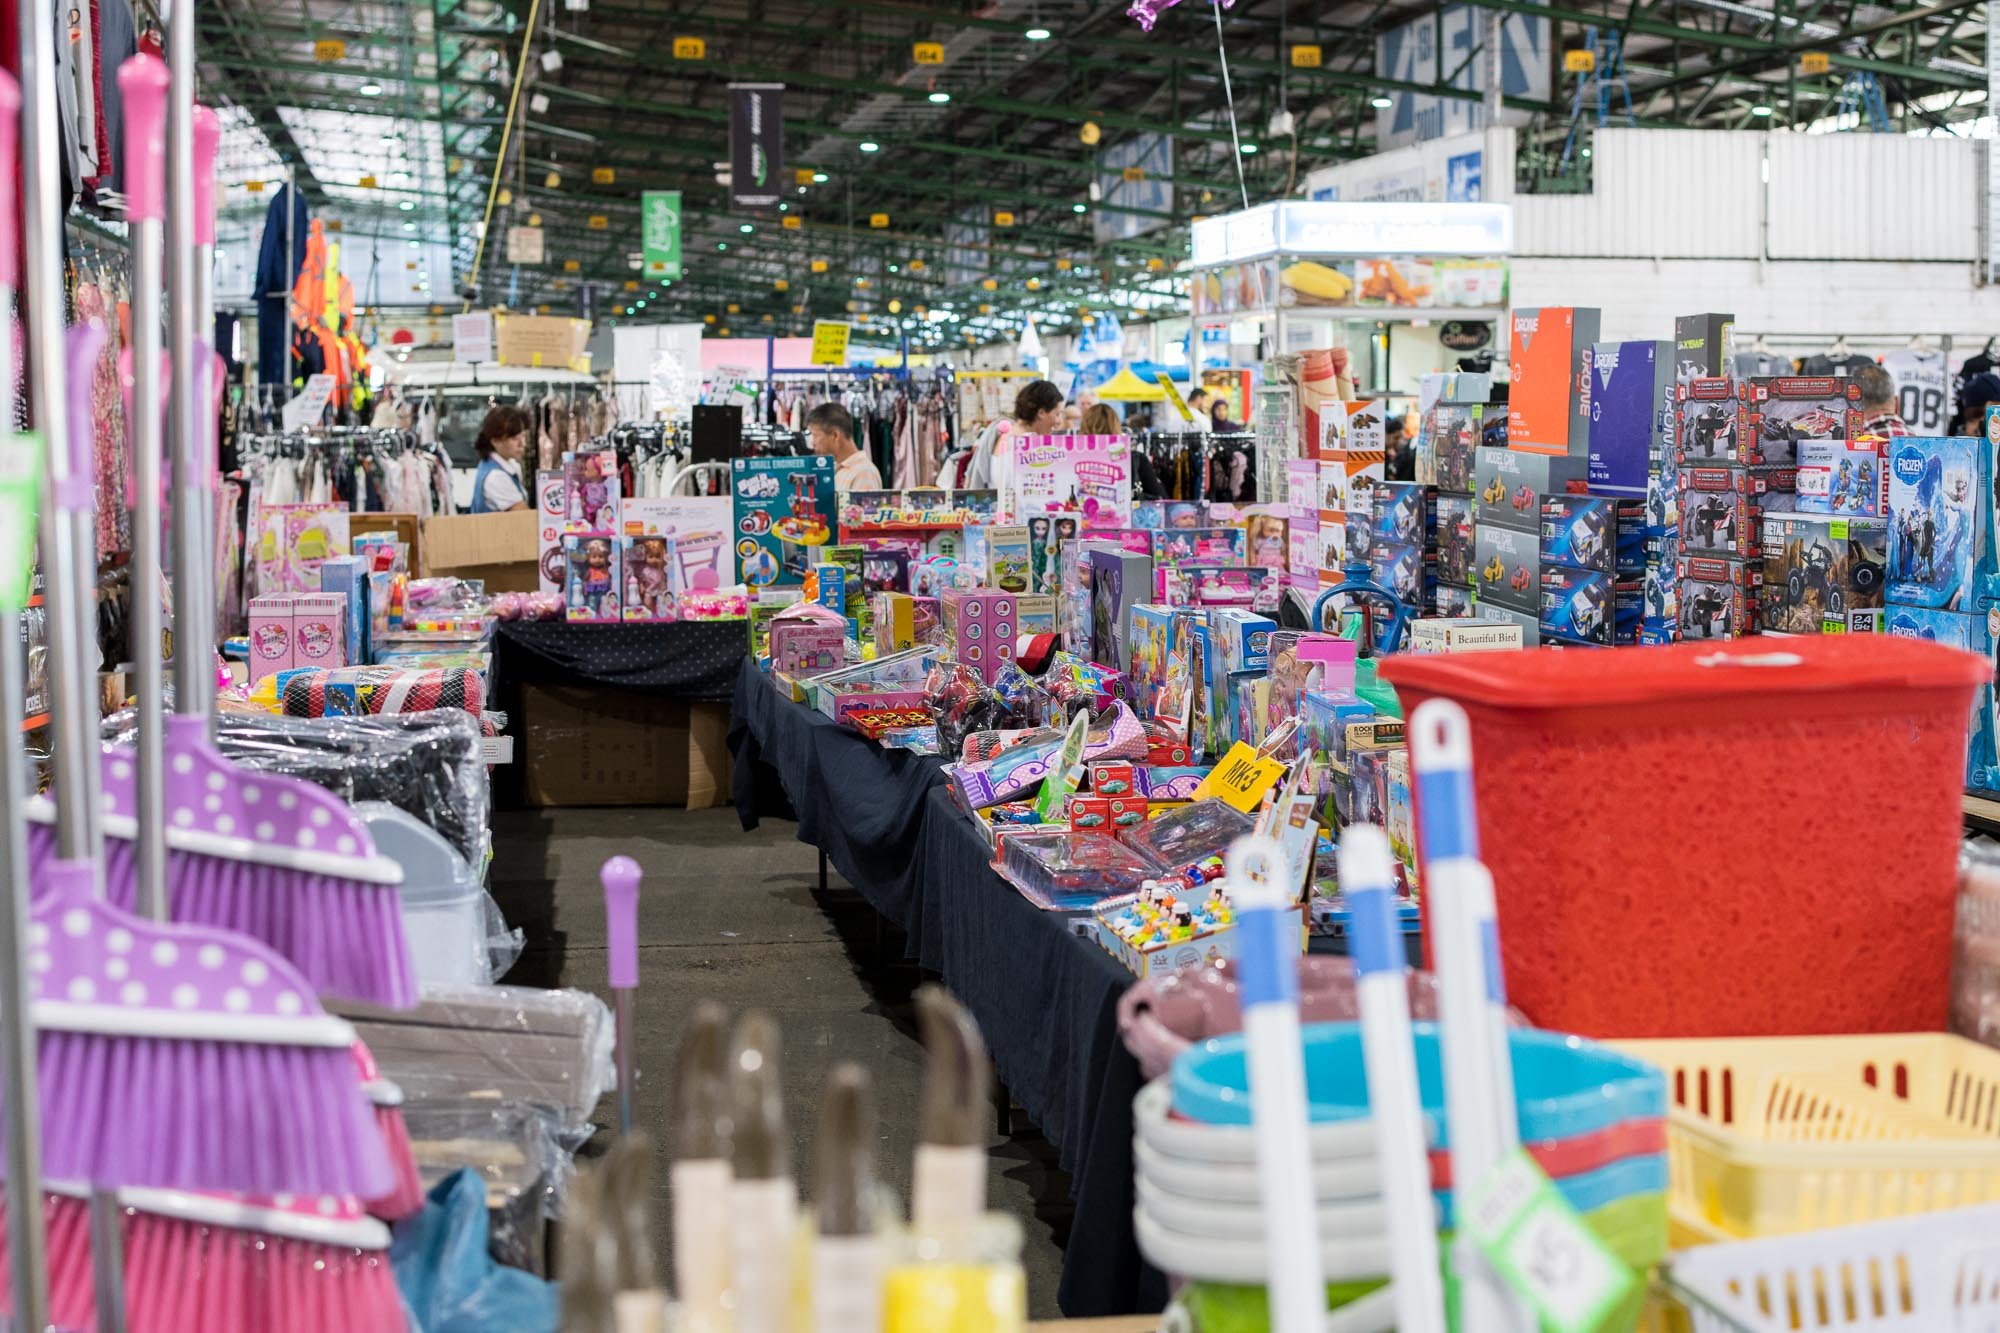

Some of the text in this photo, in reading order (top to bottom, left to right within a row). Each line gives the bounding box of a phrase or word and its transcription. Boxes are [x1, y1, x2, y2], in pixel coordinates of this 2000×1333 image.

[1514, 318, 1539, 332] DRONE
[1594, 353, 1619, 368] DRONE
[1580, 349, 1592, 416] DRONE
[1900, 386, 1942, 429] 08
[1020, 451, 1065, 465] Kitchen
[1897, 459, 1924, 472] FROZEN
[875, 510, 975, 524] Happy Family
[1854, 615, 1871, 623] 2.4
[1853, 623, 1871, 631] GHz
[1892, 624, 1918, 639] FROZEN
[1458, 633, 1517, 644] Beautiful Bird
[1378, 724, 1405, 736] SUV
[1222, 759, 1262, 792] MK-3
